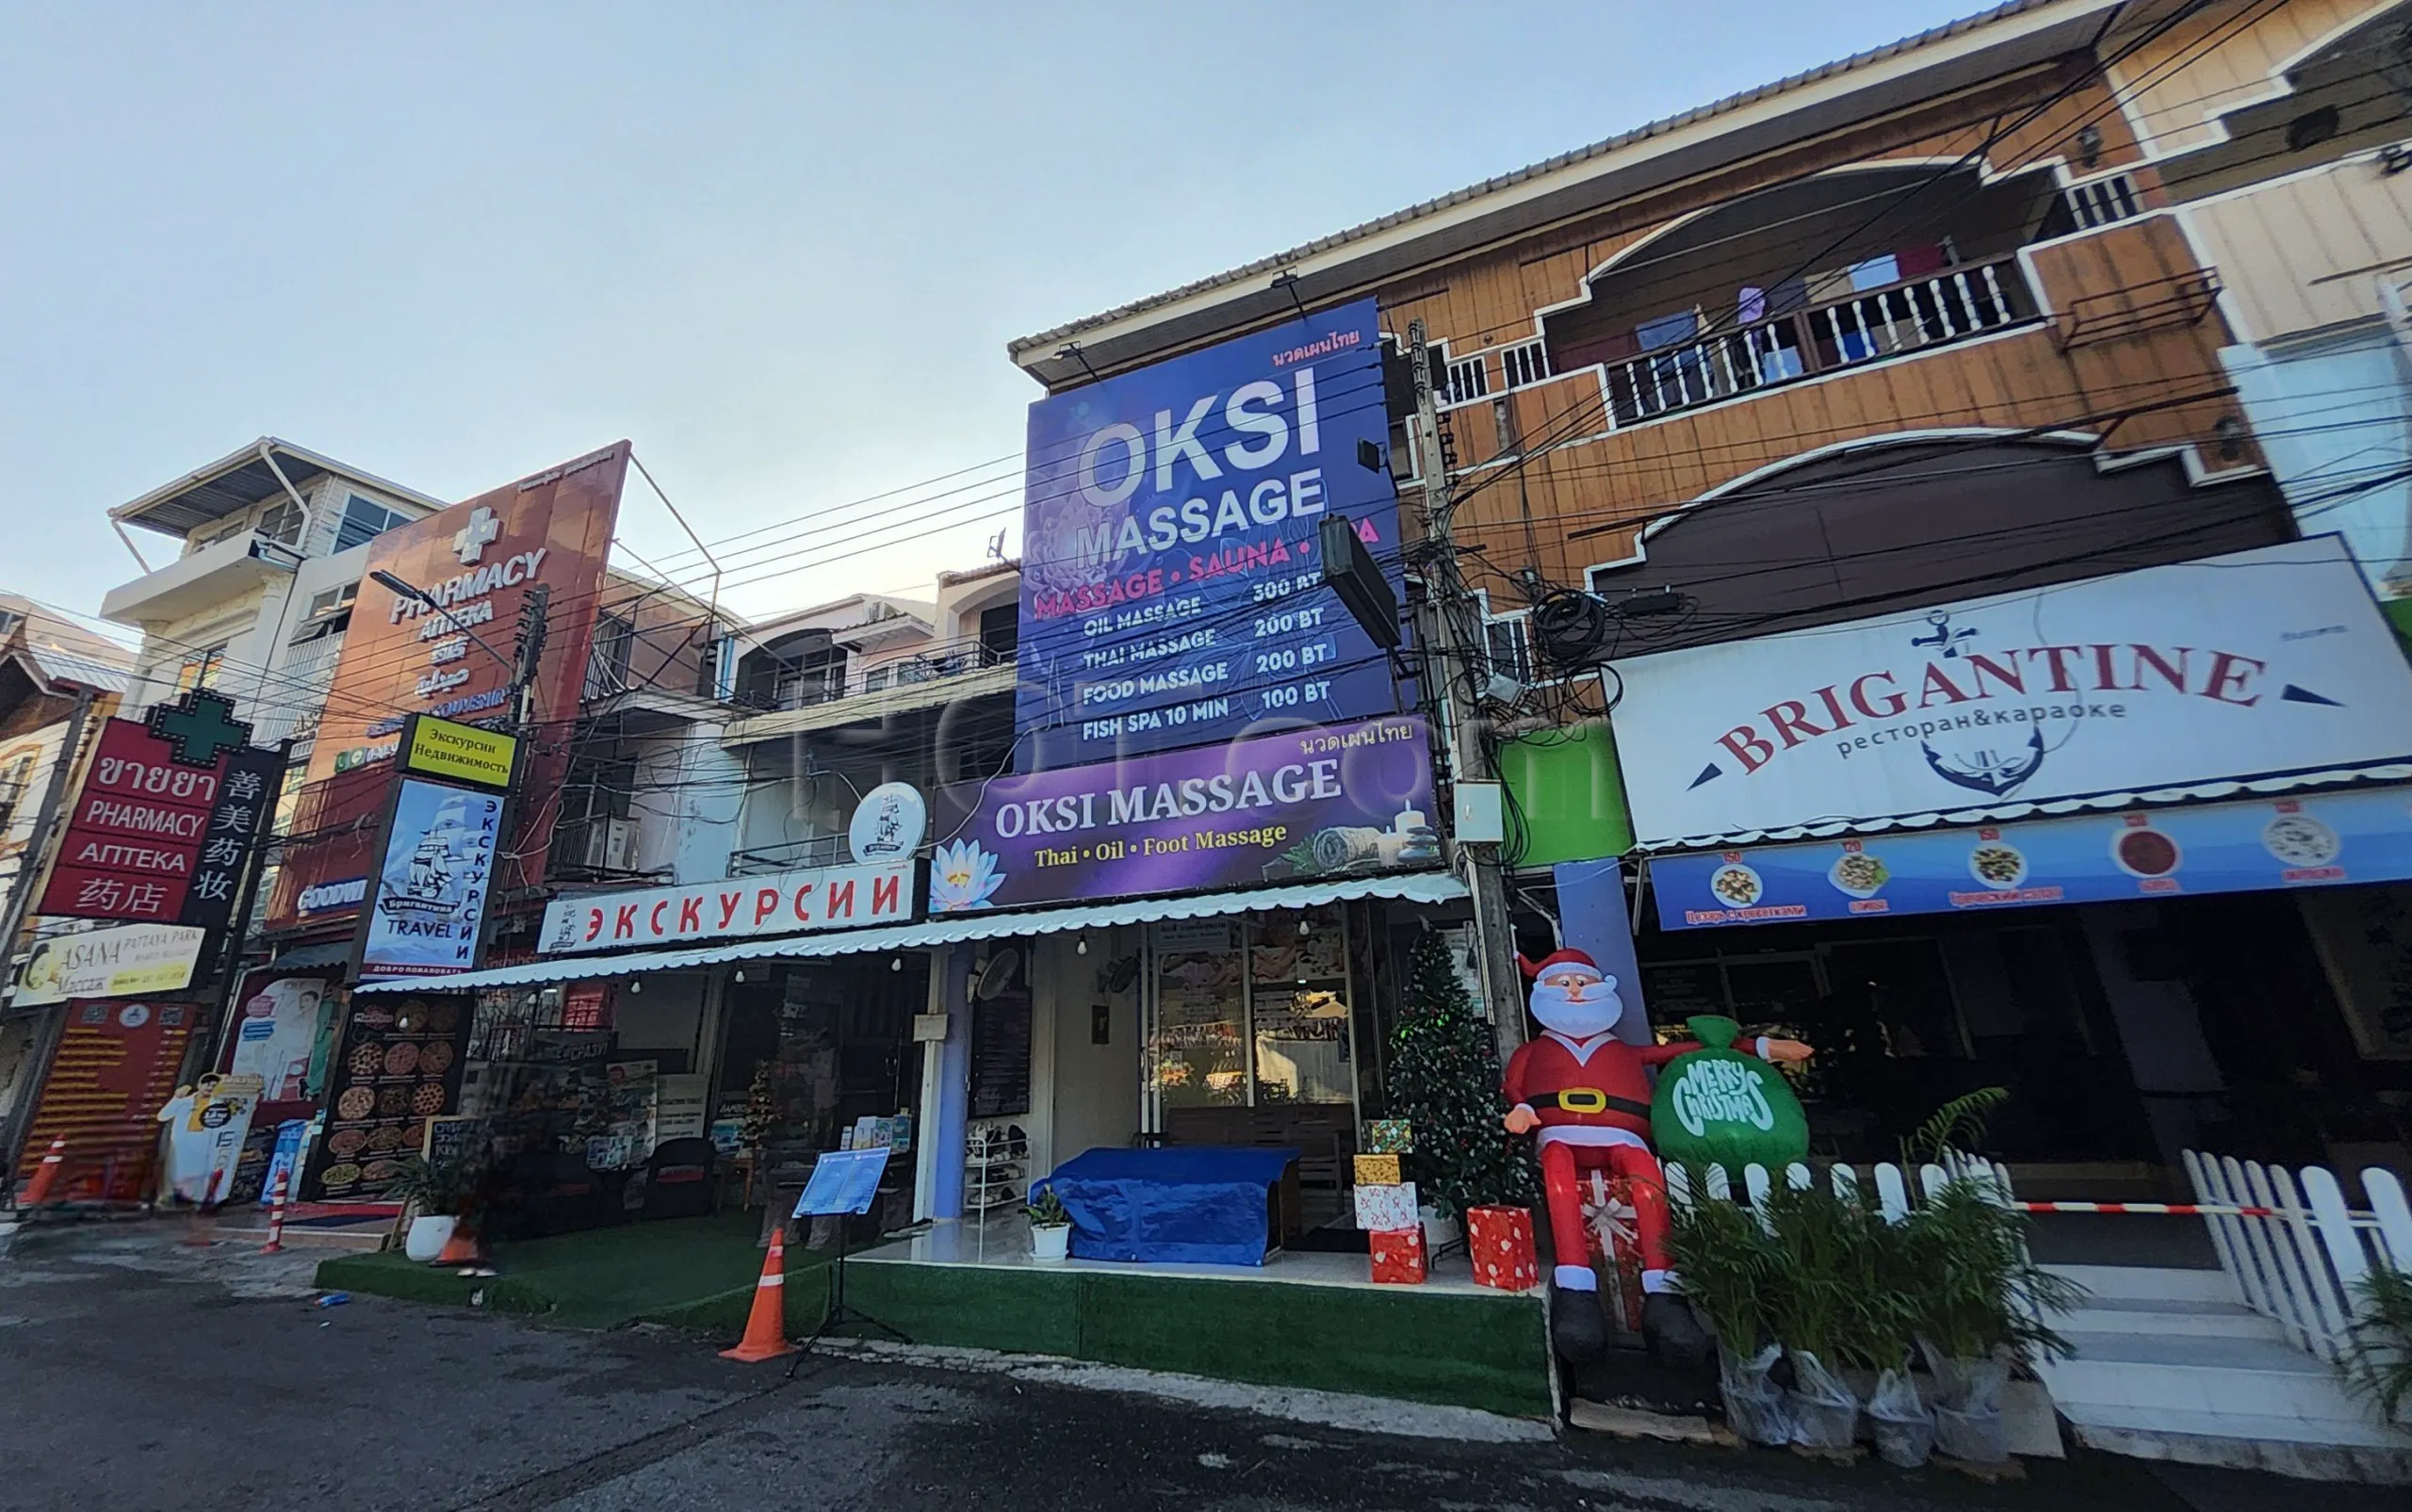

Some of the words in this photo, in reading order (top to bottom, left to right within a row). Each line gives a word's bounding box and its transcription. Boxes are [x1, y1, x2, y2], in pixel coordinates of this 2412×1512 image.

[1077, 367, 1319, 508] OKSI
[1076, 467, 1326, 569] MASSAGE
[1035, 568, 1165, 620] MASSAGE
[1187, 537, 1290, 581] SAUNA
[1252, 579, 1291, 602] 300
[1084, 619, 1112, 637] OIL
[1116, 596, 1202, 628] MASSAGE
[1254, 613, 1293, 637] 200
[1298, 608, 1325, 629] BT
[1084, 650, 1125, 669] THAI
[1131, 628, 1216, 660] MASSAGE
[1256, 650, 1296, 674] 200
[1301, 643, 1328, 665] BT
[1083, 682, 1135, 706] FOOD
[1140, 662, 1229, 695] MASSAGE
[1262, 687, 1298, 709] 100
[1305, 681, 1330, 703] BT
[1083, 717, 1122, 740] FISH
[1127, 711, 1163, 733] SPA
[1165, 706, 1187, 726] 10
[1193, 698, 1229, 723] MIN
[1713, 642, 2267, 775] BRIGANTINE
[429, 728, 497, 755] Экскурсии
[1835, 700, 2127, 759] ресторан&караоке
[98, 756, 217, 801] ขายยา
[415, 742, 509, 774] Недвижимость
[85, 800, 205, 837] PHARMACY
[995, 792, 1096, 839] OKSI
[1106, 757, 1343, 827] MASSAGE
[193, 770, 262, 902] 善美药妆
[1035, 849, 1078, 869] Thai
[1096, 842, 1125, 862] Oil
[1143, 835, 1189, 858] Foot
[1194, 822, 1287, 854] Massage
[77, 842, 186, 872] АПТЕКА
[75, 877, 168, 913] 药店
[456, 800, 497, 960] ЭКСКУРСИИ
[387, 919, 453, 938] TRAVEL
[585, 874, 899, 942] ЭКСКУРСИИ
[373, 965, 405, 973] ДОБРО
[405, 967, 463, 975] ПОЖАЛОВАТЬ
[1687, 1059, 1748, 1096] MERRY
[1672, 1070, 1774, 1137] CHRISTMAS
